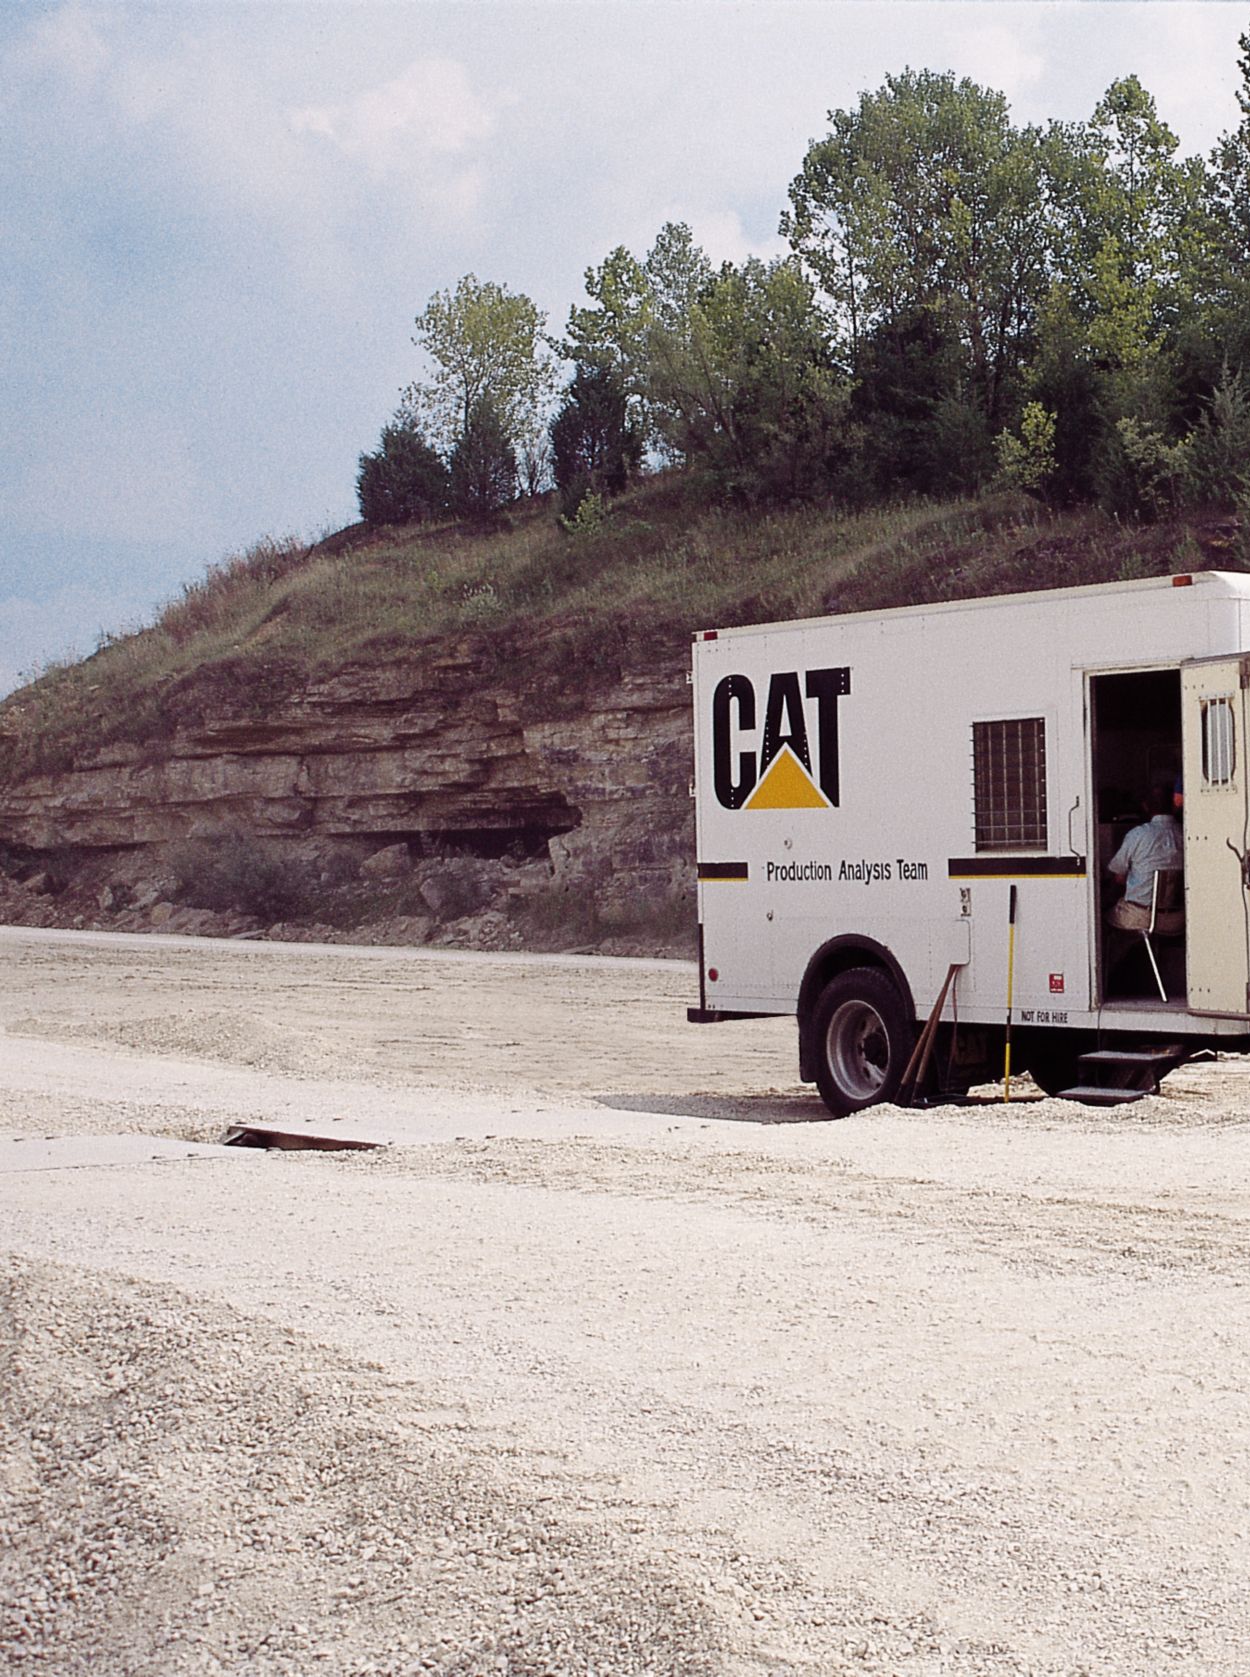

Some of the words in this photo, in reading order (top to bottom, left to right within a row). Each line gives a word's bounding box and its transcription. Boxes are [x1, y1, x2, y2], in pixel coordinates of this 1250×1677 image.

[713, 666, 851, 810] CAT
[767, 861, 832, 881] Production
[838, 859, 891, 885] Analysis
[896, 859, 928, 880] Team
[1021, 1010, 1034, 1022] NOT
[1037, 1011, 1050, 1023] FOR
[1051, 1011, 1068, 1024] HIRE
